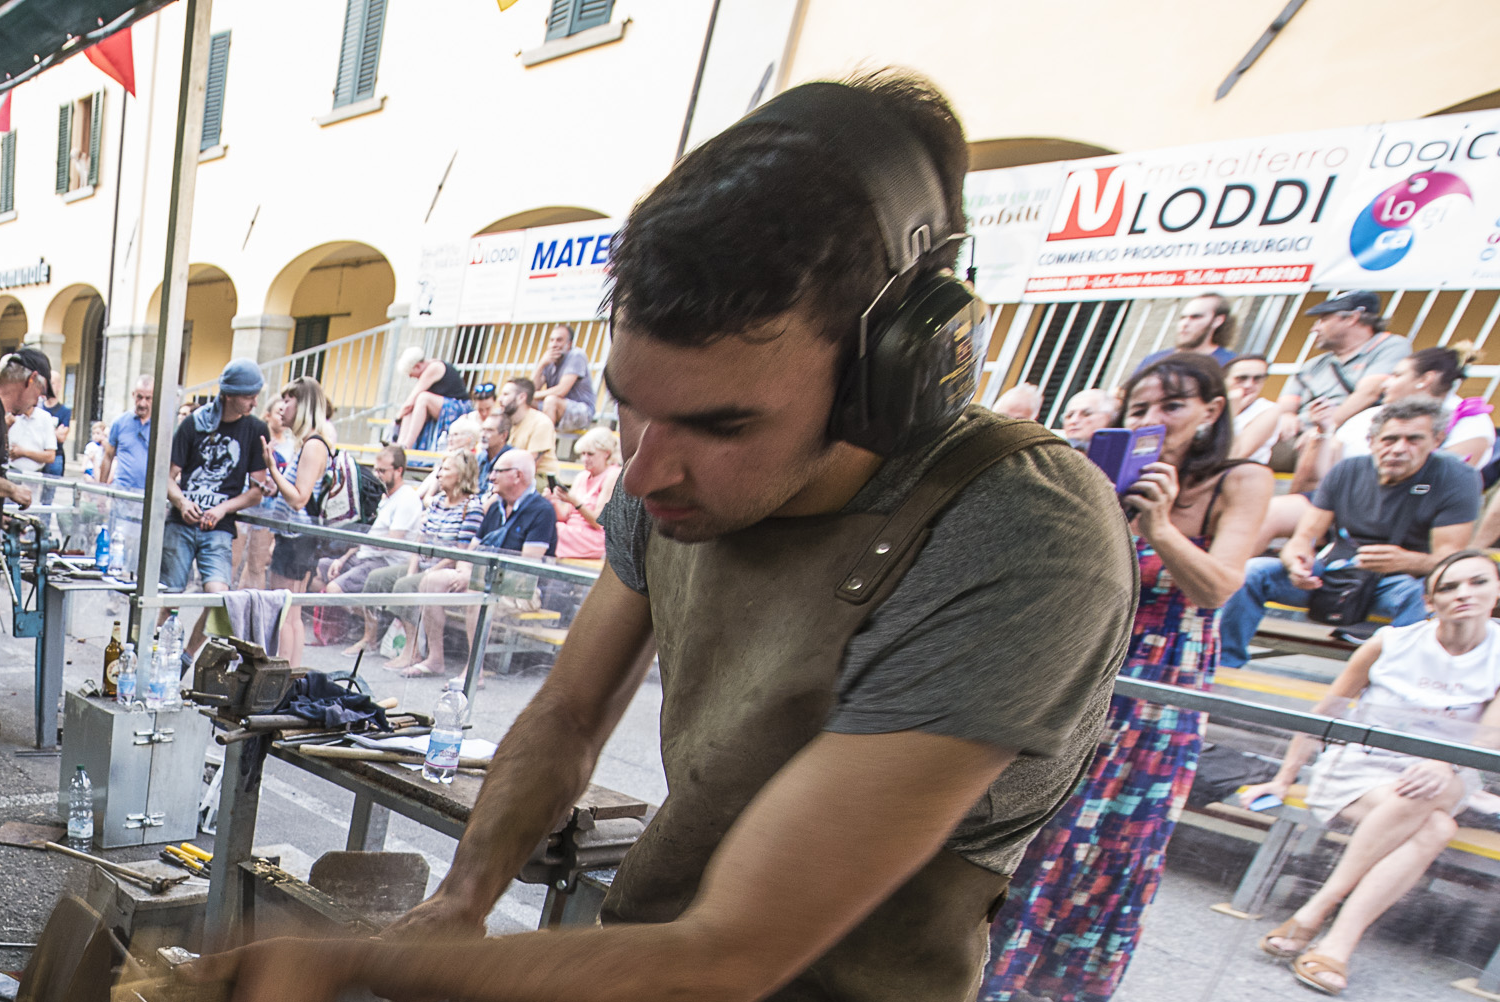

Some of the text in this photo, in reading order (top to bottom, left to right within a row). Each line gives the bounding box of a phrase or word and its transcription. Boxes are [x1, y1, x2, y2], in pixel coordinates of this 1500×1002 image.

[1143, 146, 1349, 185] metalferro
[1369, 124, 1500, 186] logic
[1128, 174, 1337, 235] LODDI
[1037, 236, 1313, 266] COMMERCIO PRODOTTI SIDERURGICI
